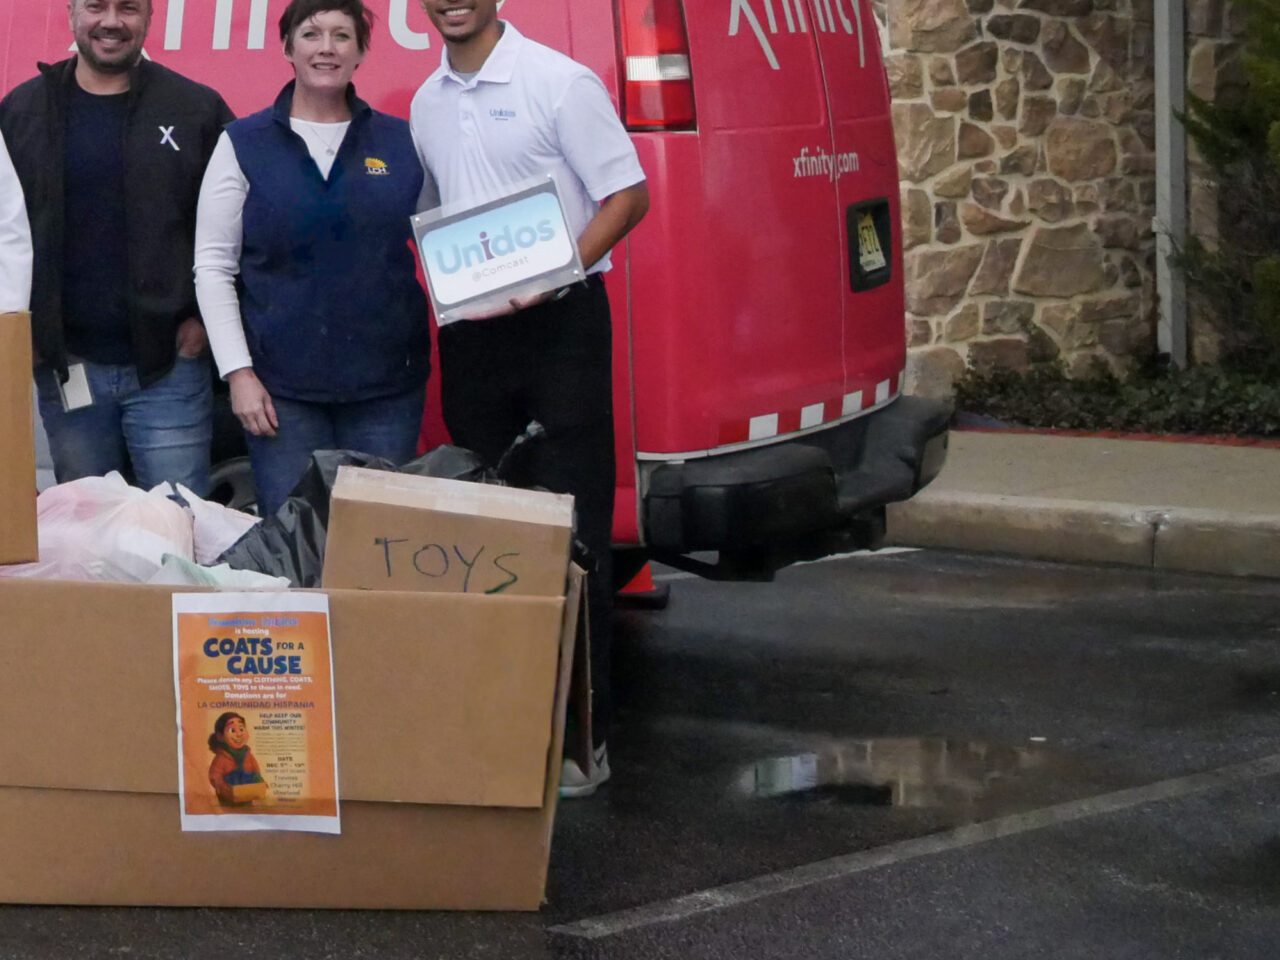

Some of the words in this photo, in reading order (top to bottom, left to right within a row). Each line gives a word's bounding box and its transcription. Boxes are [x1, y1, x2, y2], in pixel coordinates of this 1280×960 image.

[434, 219, 556, 275] Unidos
[471, 255, 530, 282] @Comcast
[374, 537, 521, 594] TOYS
[203, 637, 273, 657] COATS
[276, 642, 294, 650] FOR
[298, 642, 304, 650] A
[227, 655, 302, 675] CAUSE
